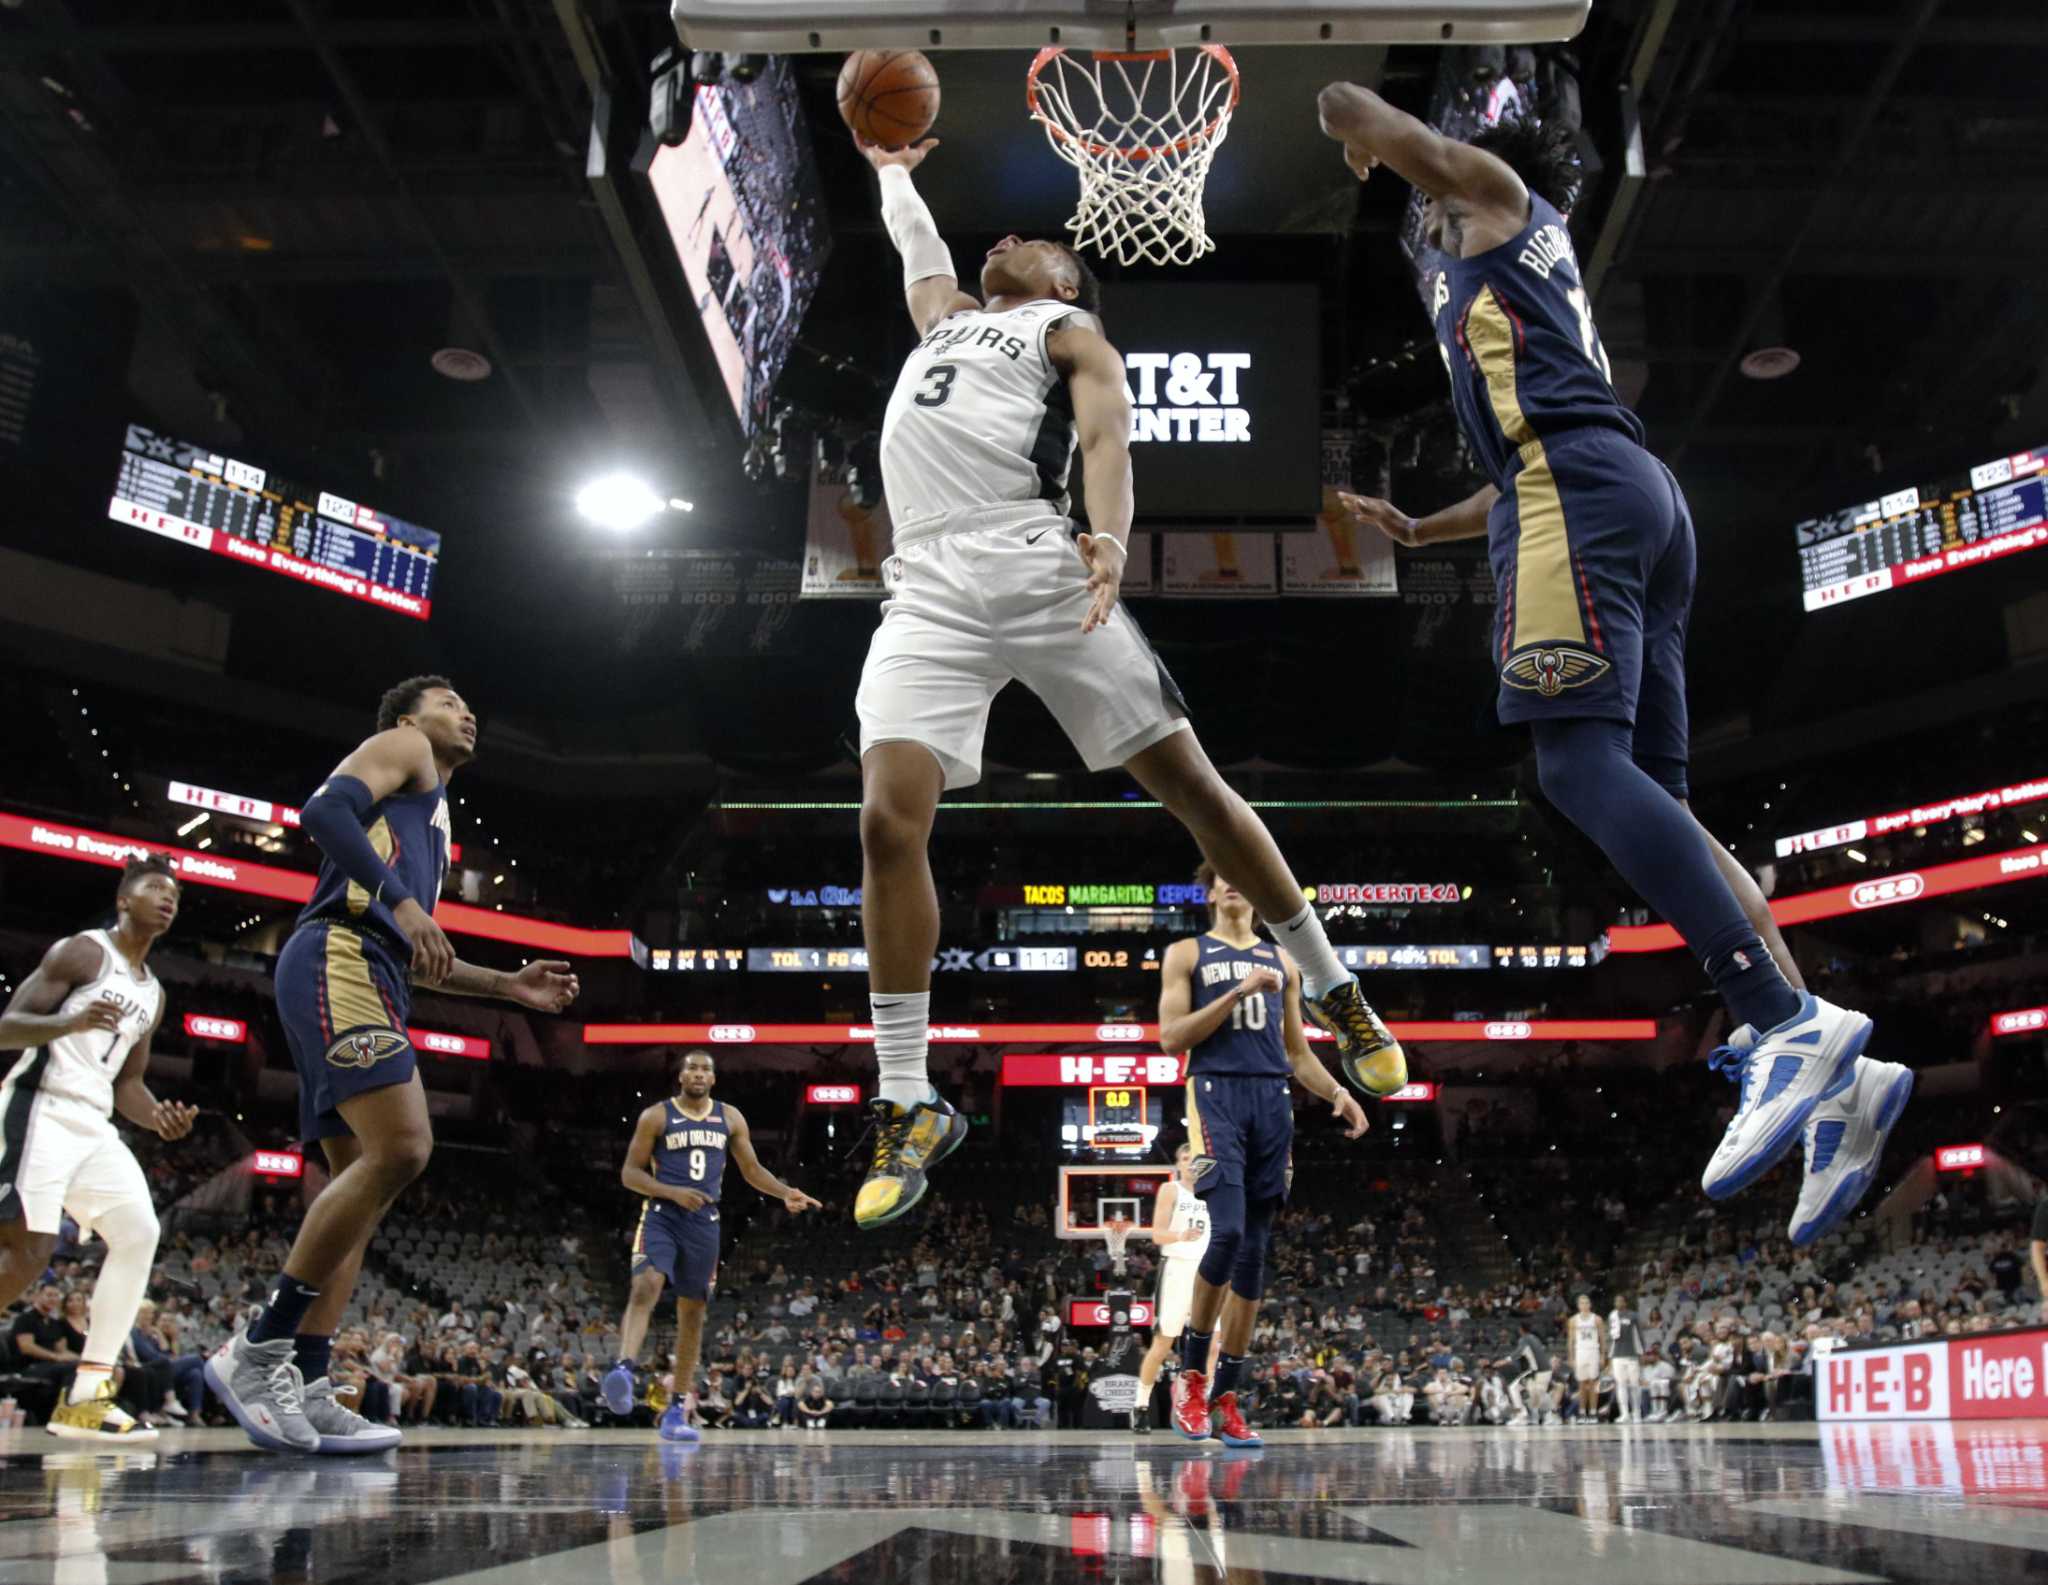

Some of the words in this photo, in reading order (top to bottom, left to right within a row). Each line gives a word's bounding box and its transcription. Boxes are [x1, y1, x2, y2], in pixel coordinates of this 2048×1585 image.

[918, 325, 1027, 361] PURS
[913, 364, 957, 407] 3
[231, 464, 260, 486] 114
[1977, 463, 2011, 482] 123
[325, 498, 355, 514] 123
[1885, 492, 1916, 509] 114
[1023, 884, 1065, 905] TACOS
[1068, 884, 1154, 905] MARGARITAS
[1157, 884, 1208, 904] CERVEZ
[827, 952, 849, 967] FG
[1024, 951, 1066, 969] 114
[1084, 951, 1129, 968] 00.2
[1366, 951, 1388, 965] FG
[1429, 950, 1460, 965] TOL
[1201, 961, 1231, 988] NEW
[101, 989, 151, 1025] SPUR
[1232, 992, 1267, 1030] 10
[102, 1032, 121, 1064] 1
[1060, 1056, 1180, 1084] H-E-B
[665, 1130, 688, 1151] NEW
[688, 1129, 728, 1150] ORLEANS
[689, 1149, 706, 1181] 9
[1961, 1347, 2035, 1401] Here
